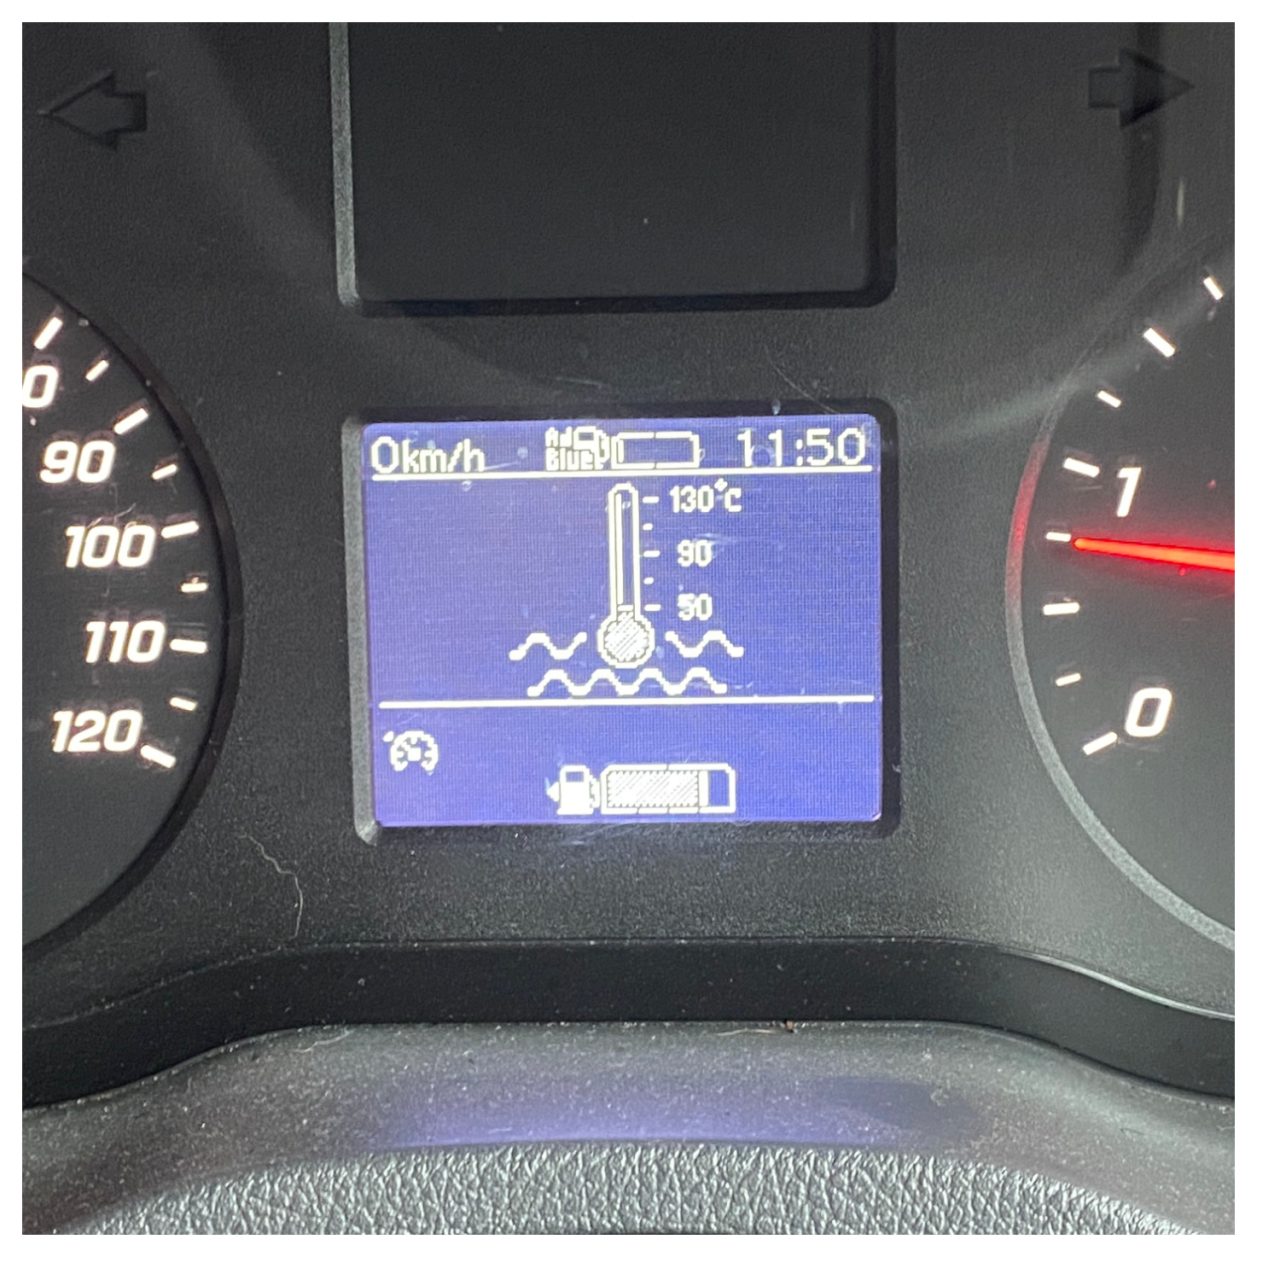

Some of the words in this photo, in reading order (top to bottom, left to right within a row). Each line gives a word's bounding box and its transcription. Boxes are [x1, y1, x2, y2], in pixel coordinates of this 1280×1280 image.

[370, 436, 487, 474] 0km/h
[545, 427, 572, 448] Ad
[737, 427, 866, 468] 11:50
[40, 440, 116, 484] 90
[1116, 467, 1142, 517] 1
[65, 524, 156, 568] 100
[677, 540, 713, 567] 90
[677, 593, 713, 620] 50
[84, 620, 166, 663] 110
[52, 710, 143, 753] 120
[1125, 687, 1173, 738] 0
